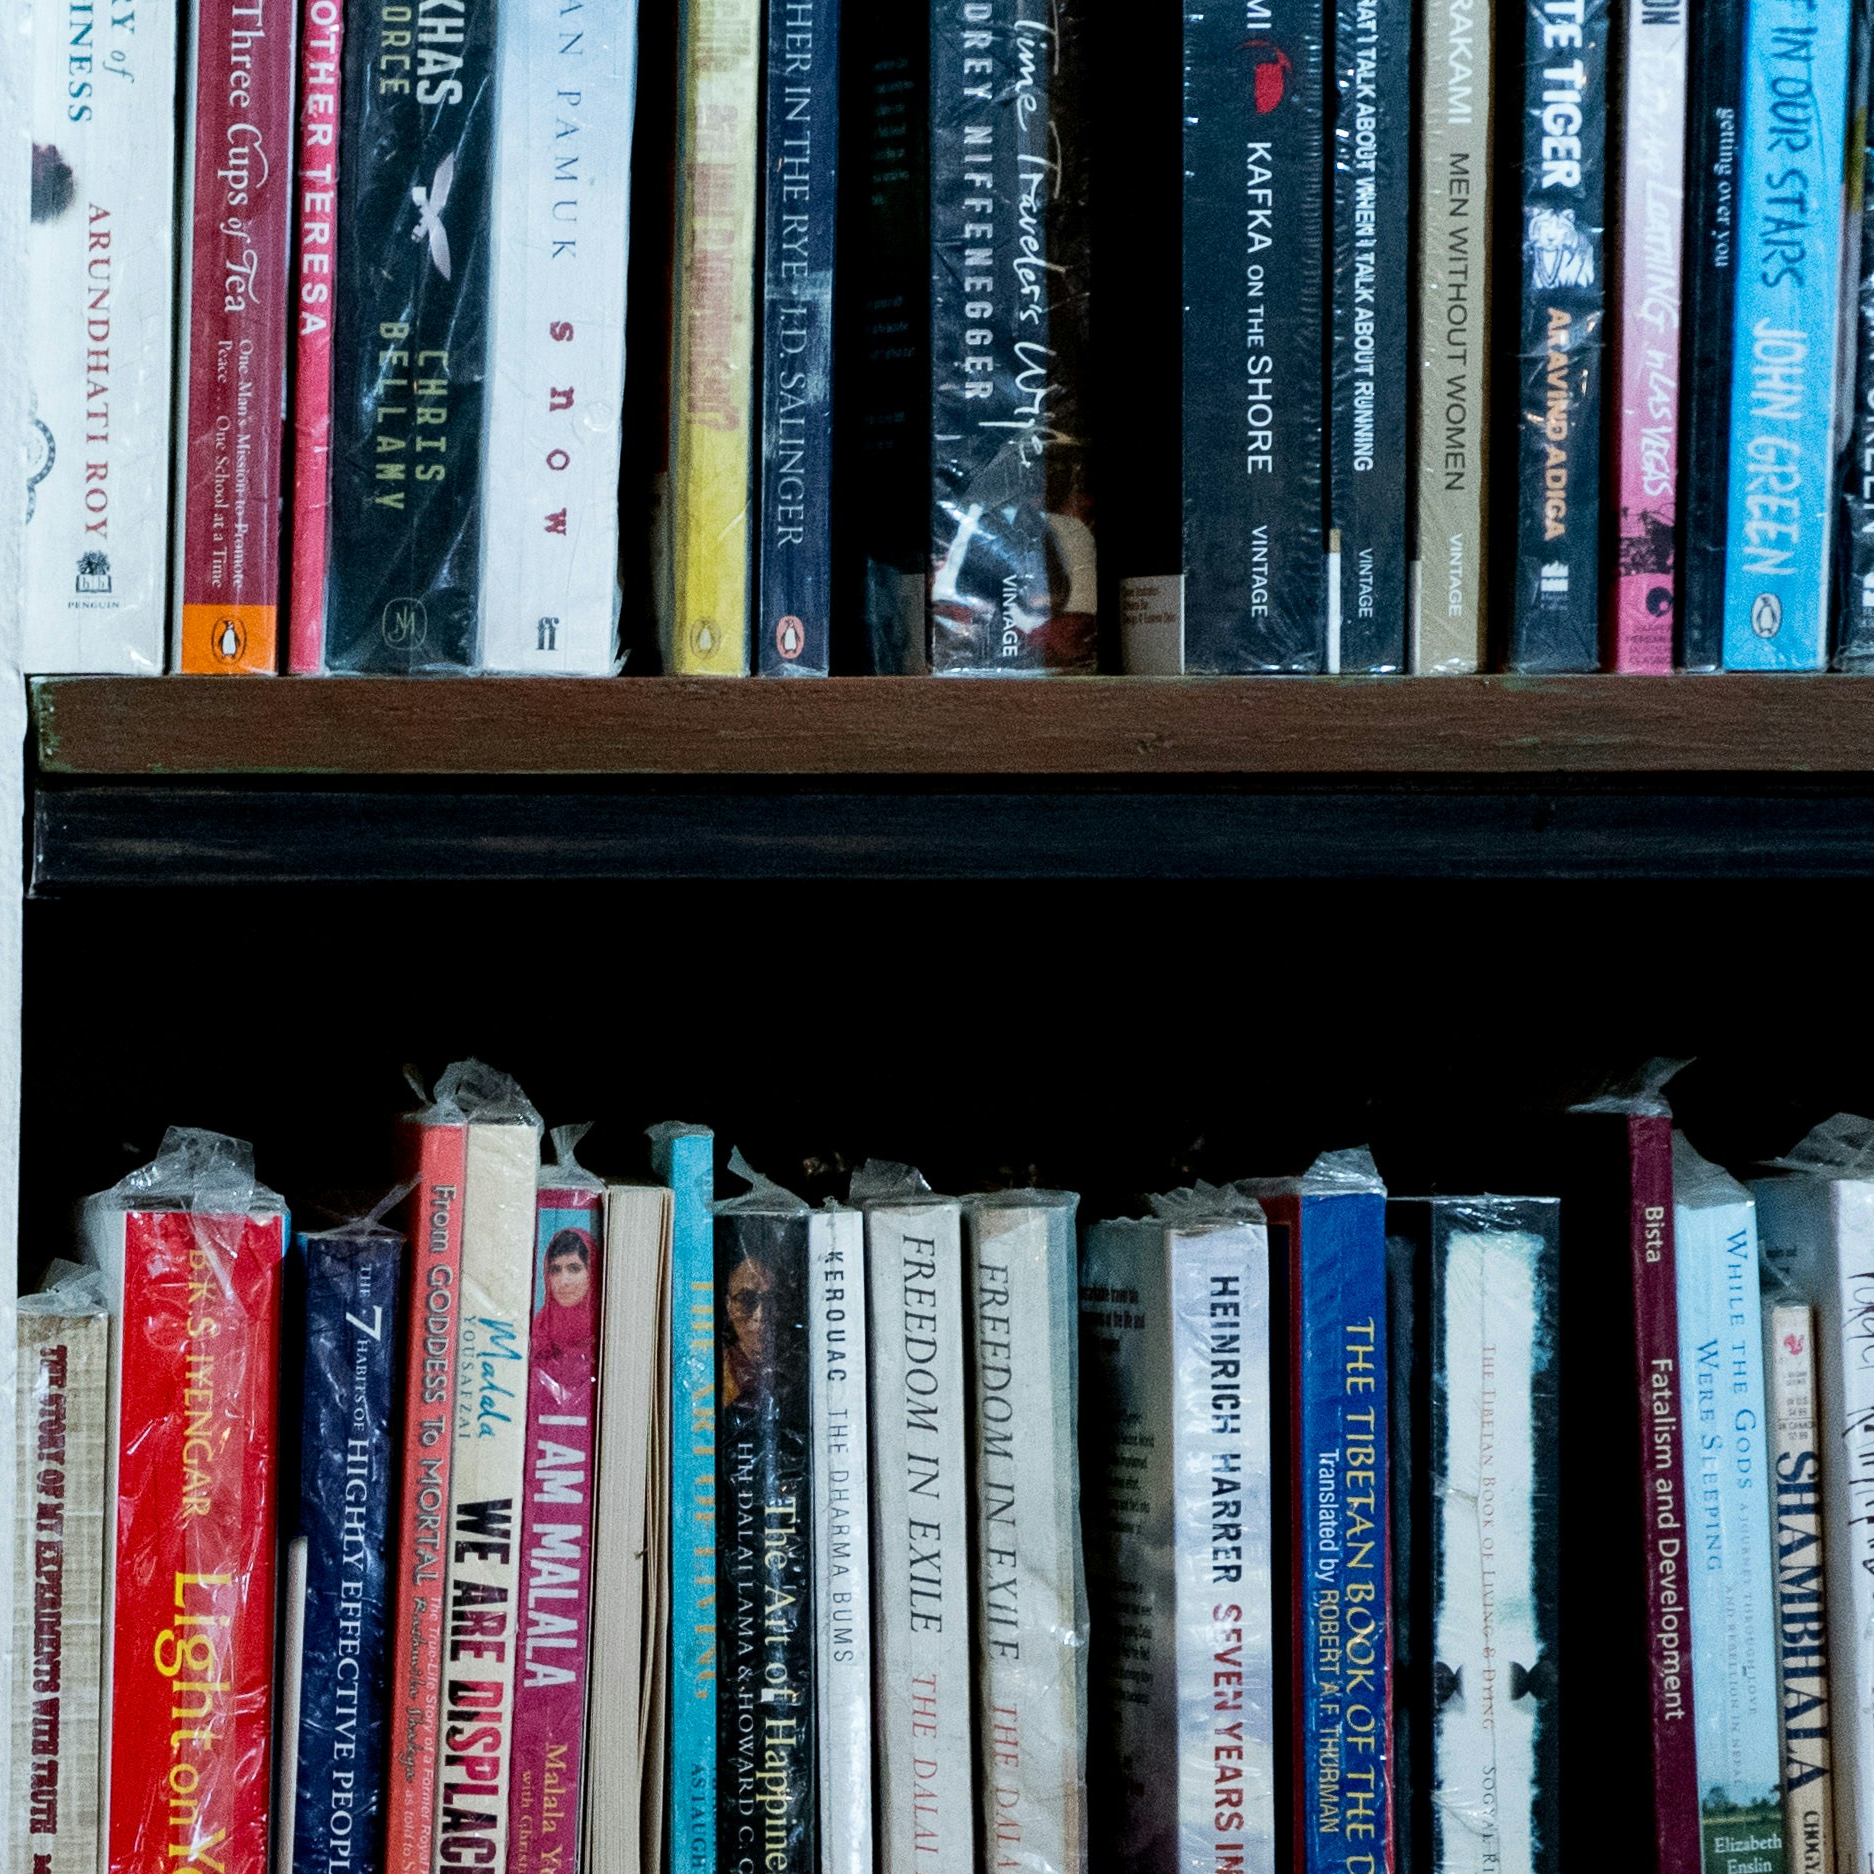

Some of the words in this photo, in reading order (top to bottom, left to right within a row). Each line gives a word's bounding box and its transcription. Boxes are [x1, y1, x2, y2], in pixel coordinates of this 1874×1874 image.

[228, 1, 265, 110] Three
[217, 121, 270, 206] Cups
[1540, 58, 1584, 189] TIGER
[1711, 106, 1734, 179] getting
[219, 211, 247, 247] of
[1246, 142, 1273, 253] KAFKA
[1447, 151, 1471, 215] MEN
[1714, 183, 1732, 219] over
[224, 249, 261, 313] Tea
[963, 125, 994, 401] NIFFENEGGER
[1248, 264, 1264, 297] ON
[1447, 226, 1470, 366] WITHOUT
[1711, 227, 1731, 268] you
[85, 203, 112, 445] ARUNDHATI
[1247, 303, 1264, 348] THE
[1547, 308, 1572, 440] ARAVIND
[1750, 319, 1808, 421] JOHN
[415, 350, 450, 483] CHRIS
[776, 369, 806, 549] SALINGER
[1247, 355, 1273, 475] SHORE
[1444, 373, 1466, 492] WOMEN
[84, 462, 110, 539] ROY
[1544, 448, 1568, 542] ADIGA
[1742, 434, 1802, 576] GREEN
[1252, 526, 1269, 618] VINTAGE
[1644, 1207, 1664, 1263] Bista
[821, 1251, 848, 1382] KEROUAC
[903, 1233, 940, 1434] FREEDOM
[1211, 1276, 1241, 1435] HEINRICH
[1651, 1359, 1673, 1467] Fatalism
[906, 1454, 940, 1499] IN
[1212, 1453, 1243, 1584] HARRER
[1656, 1477, 1678, 1528] and
[909, 1520, 943, 1634] EXILE
[1657, 1540, 1685, 1720] Development
[1777, 1452, 1830, 1793] SHAMBHALA
[153, 1571, 231, 1751] Light
[1213, 1602, 1244, 1711] SEVEN
[168, 1764, 201, 1826] on
[540, 1744, 568, 1833] Malala
[1213, 1723, 1244, 1832] YEARS
[1714, 1835, 1783, 1854] Elizabeth
[1728, 1858, 1773, 1874] Enslin
